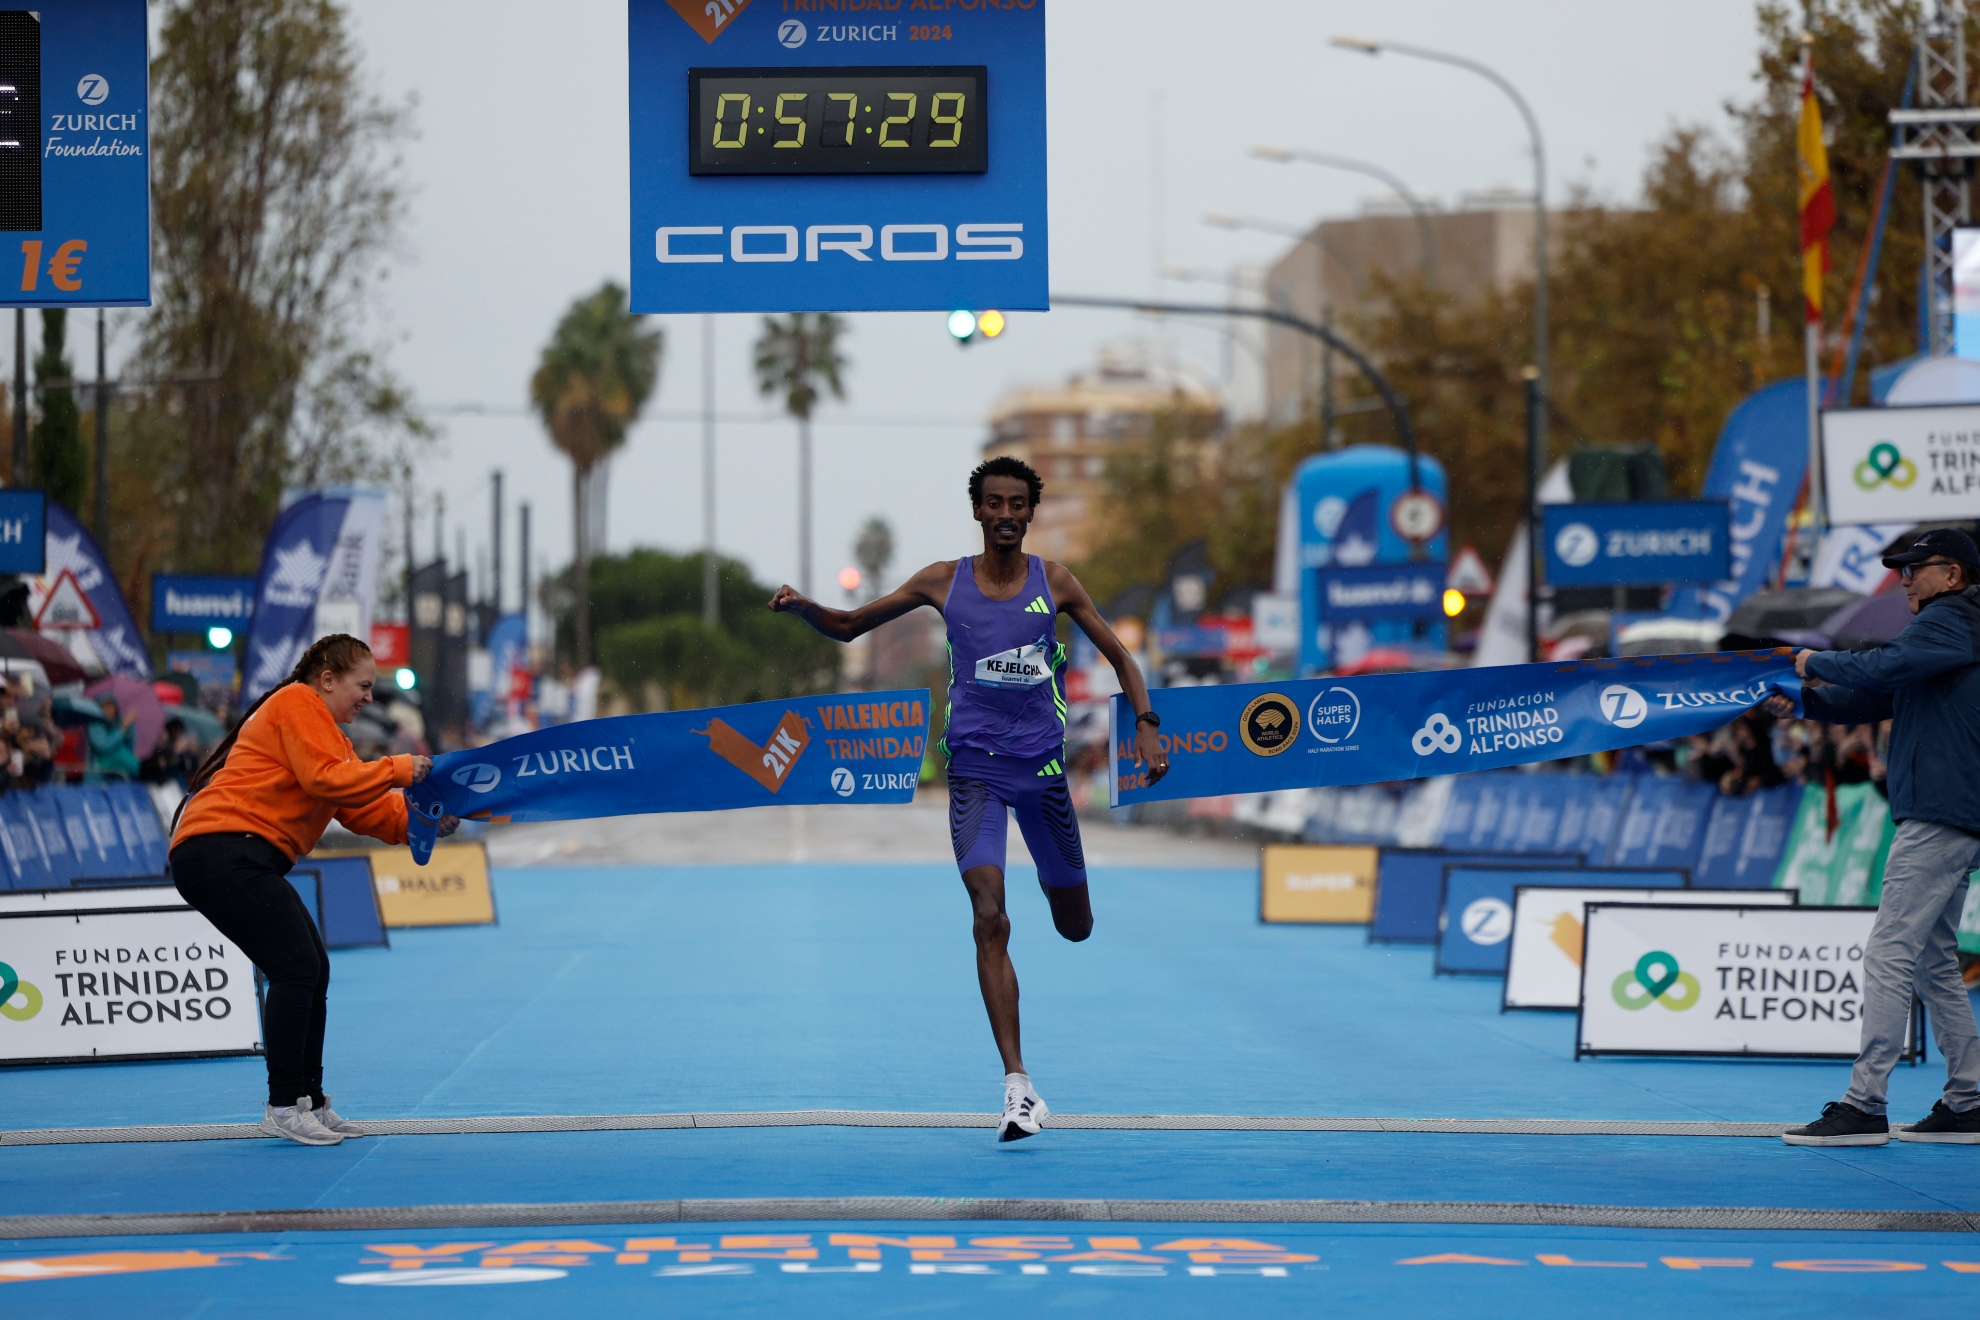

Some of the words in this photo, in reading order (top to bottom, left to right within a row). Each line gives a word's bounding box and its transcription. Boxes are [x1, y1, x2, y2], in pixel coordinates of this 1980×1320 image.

[705, 0, 746, 29] 21
[817, 26, 897, 42] ZURICH
[909, 25, 953, 41] 2024
[51, 114, 136, 131] ZURICH
[712, 92, 966, 149] 0:57:29
[45, 136, 142, 158] Foundation
[655, 223, 1024, 263] COROS
[1931, 474, 1980, 496] ALF
[987, 659, 1043, 677] KEJELCHA
[1467, 691, 1554, 714] FUNDACIÓN
[1657, 680, 1767, 710] ZURICH
[817, 701, 924, 730] VALENCIA
[1316, 714, 1351, 726] HALFS
[1317, 704, 1352, 716] SUPER
[1466, 707, 1559, 735] TRINIDAD
[762, 727, 802, 780] 21K
[825, 735, 923, 760] TRINIDAD
[1117, 730, 1228, 760] ALONSO
[1469, 726, 1563, 755] ALFONSO
[512, 746, 635, 777] ZURICH
[862, 772, 917, 790] ZURICH
[55, 943, 225, 966] FUNDACIÓN
[1718, 942, 1863, 962] FUNDACIÓ
[55, 968, 229, 997] TRINIDAD
[1716, 966, 1859, 995] TRINIDA
[60, 996, 232, 1027] ALFONSO
[1715, 997, 1863, 1022] ALFONS
